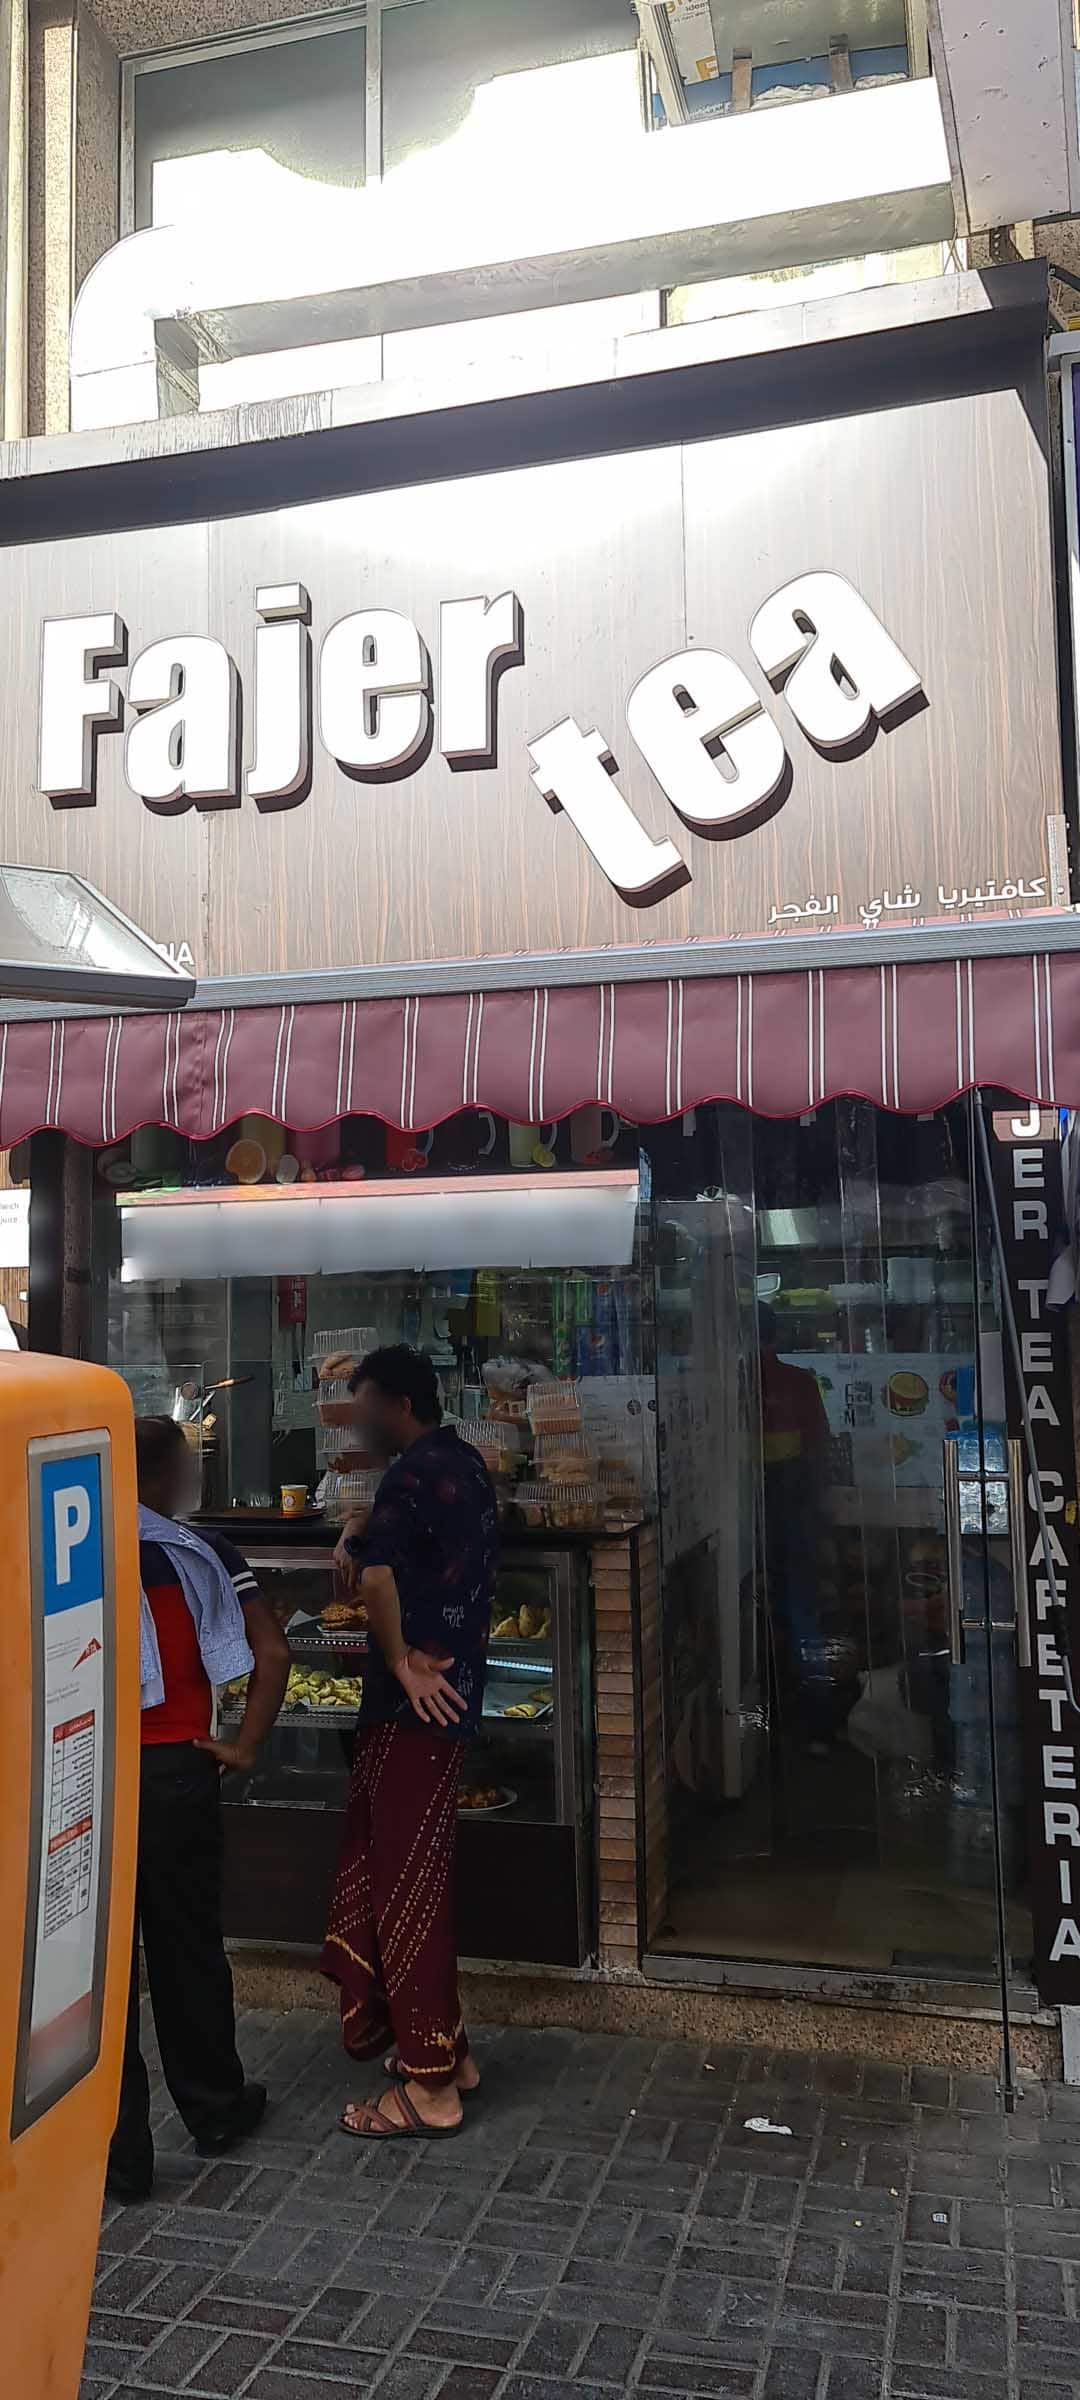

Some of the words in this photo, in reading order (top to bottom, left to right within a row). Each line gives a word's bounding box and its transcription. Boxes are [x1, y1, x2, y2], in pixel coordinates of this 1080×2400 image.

[38, 581, 522, 808] Fajer
[526, 568, 925, 903] tea
[768, 894, 839, 923] الفجر
[858, 883, 921, 922] شاي
[937, 876, 1048, 910] كافتيريا
[1018, 1279, 1061, 1426] TEA
[53, 1484, 91, 1585] P
[1027, 1470, 1080, 1961] CAFETERIA
